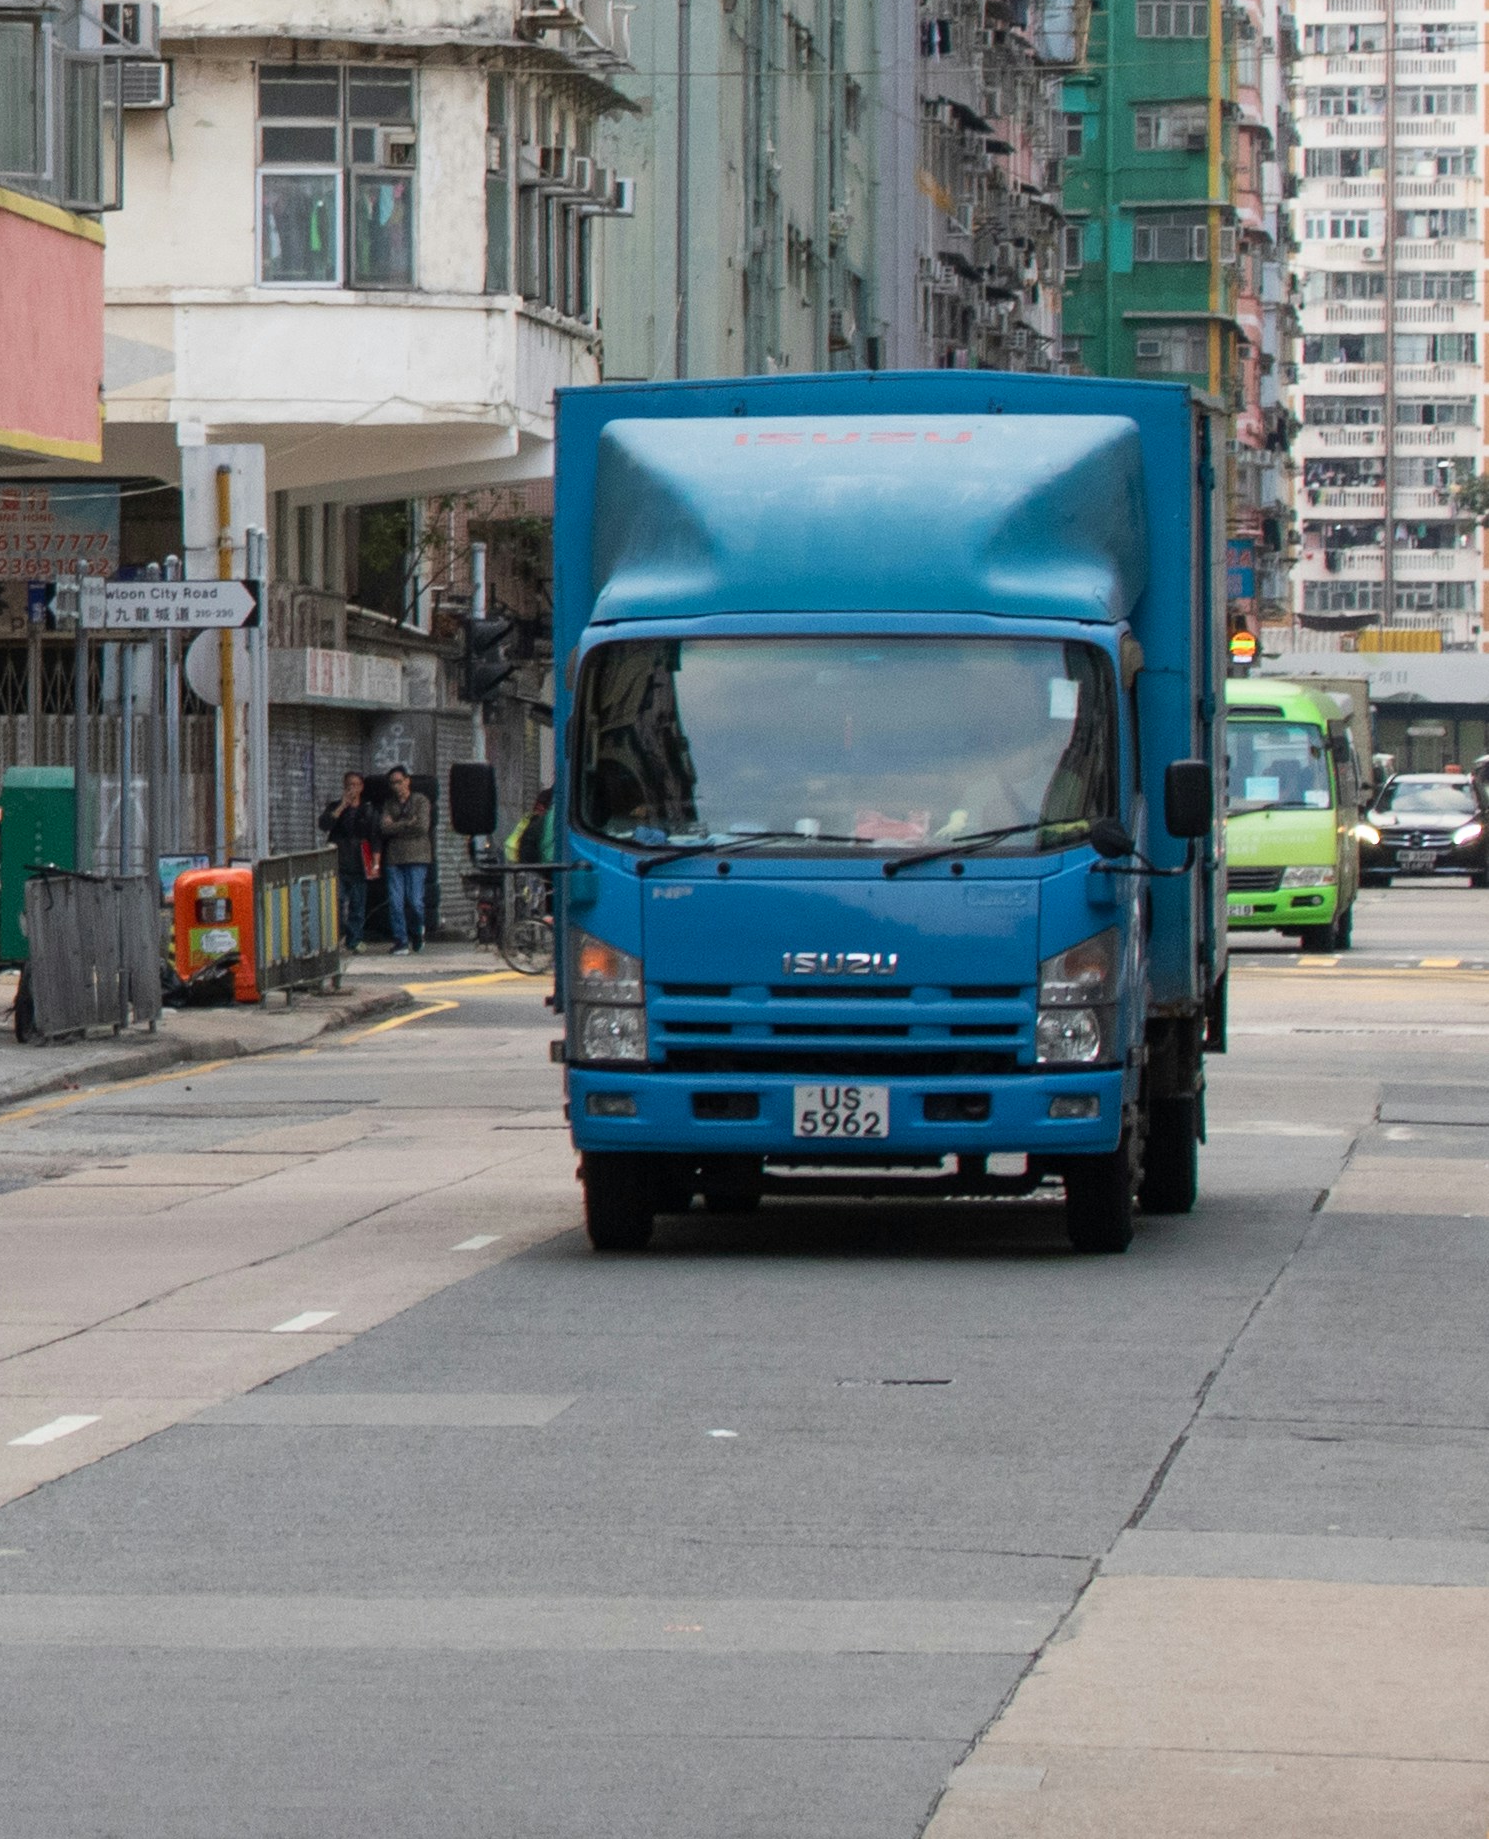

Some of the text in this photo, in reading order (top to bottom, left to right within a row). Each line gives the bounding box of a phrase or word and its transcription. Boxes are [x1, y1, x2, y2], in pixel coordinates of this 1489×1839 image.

[734, 431, 973, 447] ISUZU
[106, 587, 218, 602] wloon City Road
[781, 951, 899, 976] ISUZU
[821, 1086, 862, 1110] US
[800, 1109, 882, 1137] 5962
